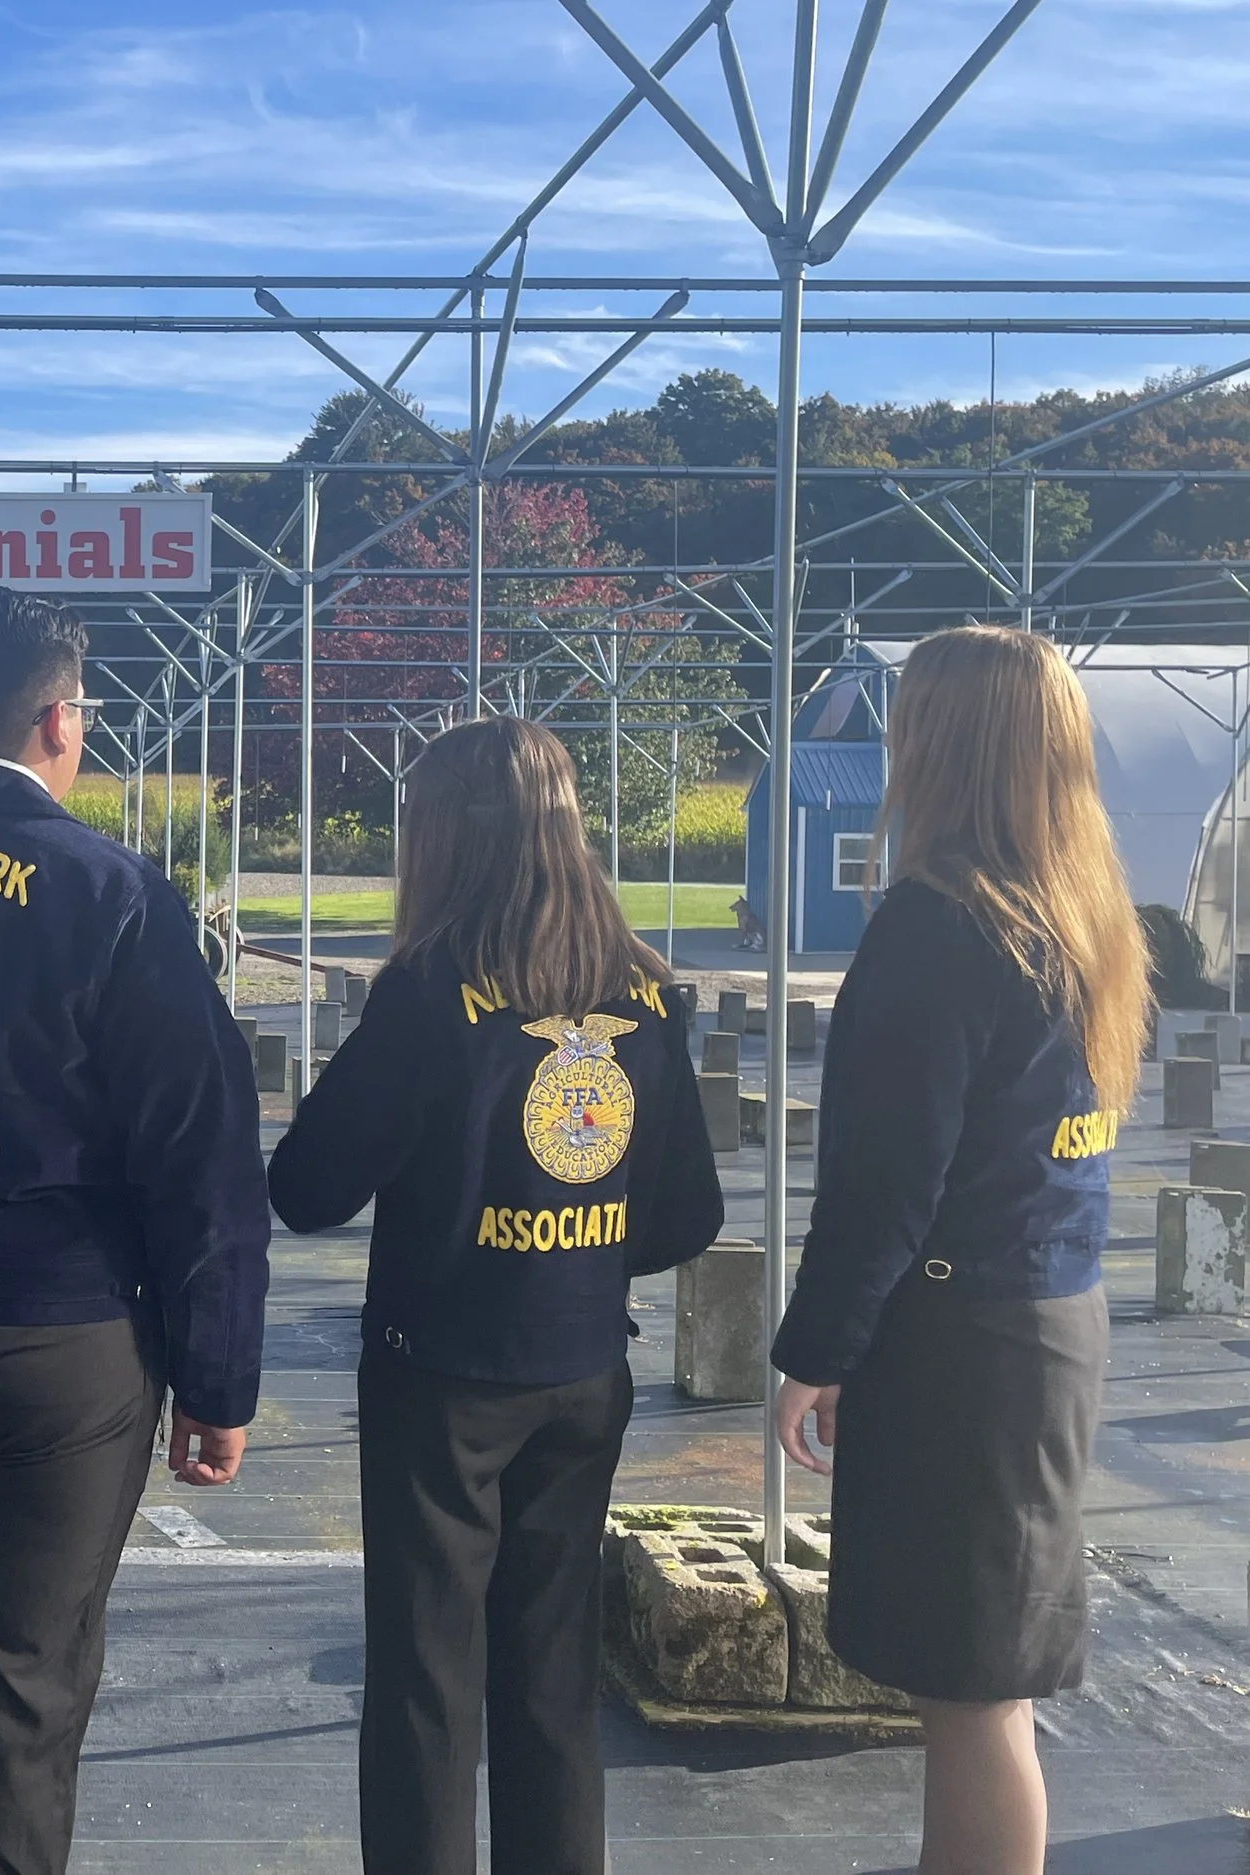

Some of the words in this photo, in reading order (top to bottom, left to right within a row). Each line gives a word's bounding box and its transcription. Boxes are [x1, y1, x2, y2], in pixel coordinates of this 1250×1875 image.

[541, 1072, 619, 1110] AGRICULTURAL
[561, 1087, 604, 1107] FFA
[550, 1139, 612, 1163] EDUCATION
[477, 1201, 627, 1252] ASSOCIATI
